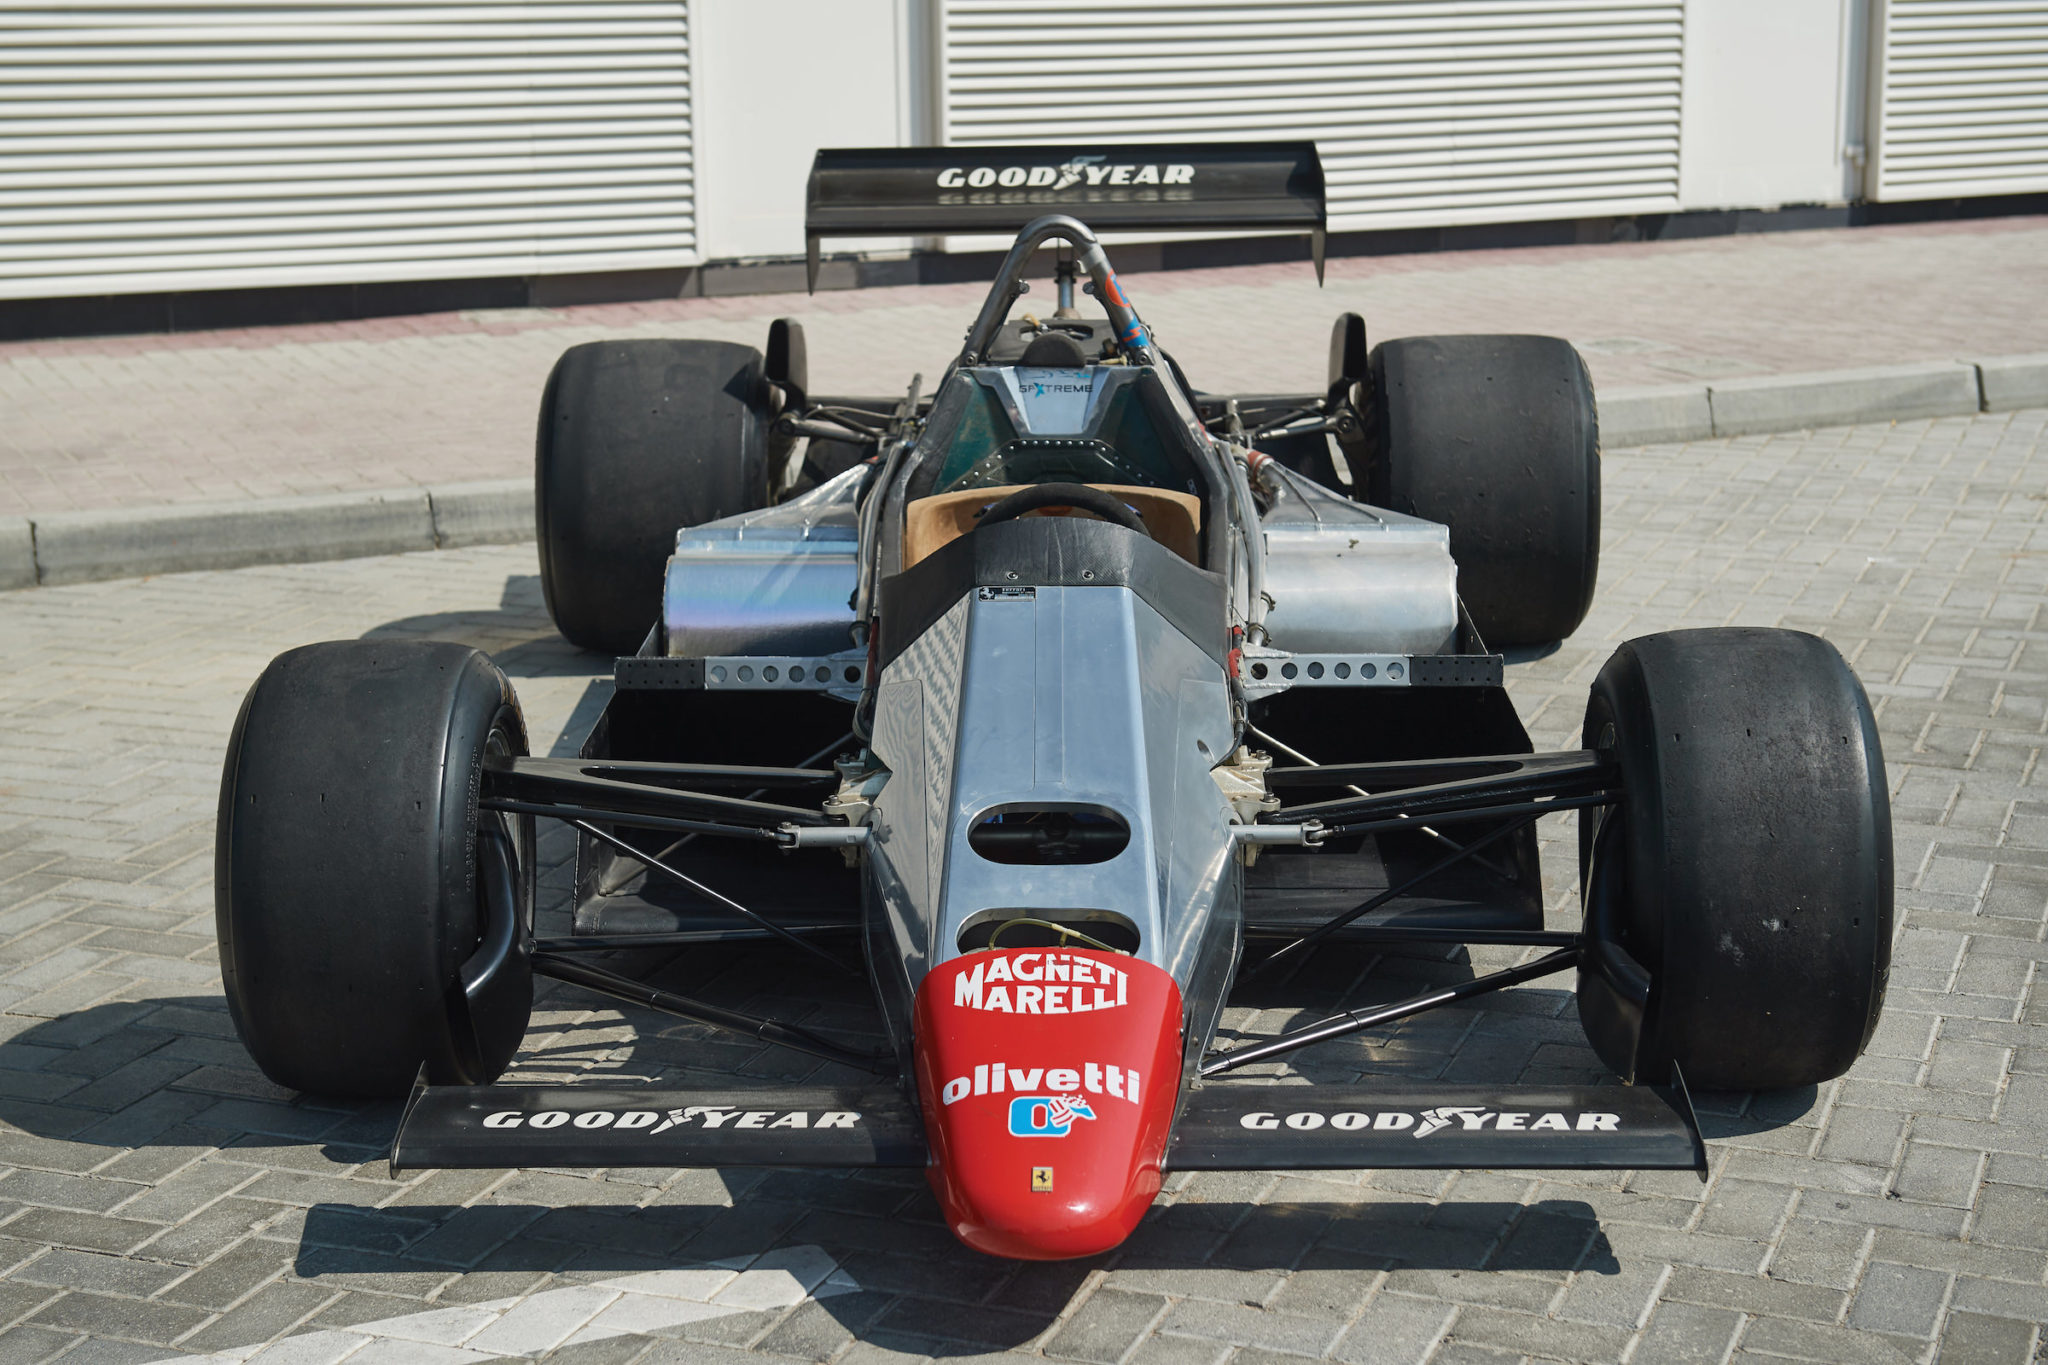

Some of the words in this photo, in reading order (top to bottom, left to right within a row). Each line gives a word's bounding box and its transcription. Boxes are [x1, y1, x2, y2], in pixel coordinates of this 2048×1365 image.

[954, 953, 1128, 1003] MAGNETI
[954, 968, 1128, 1014] MARELLI
[943, 1063, 1140, 1105] olivetti
